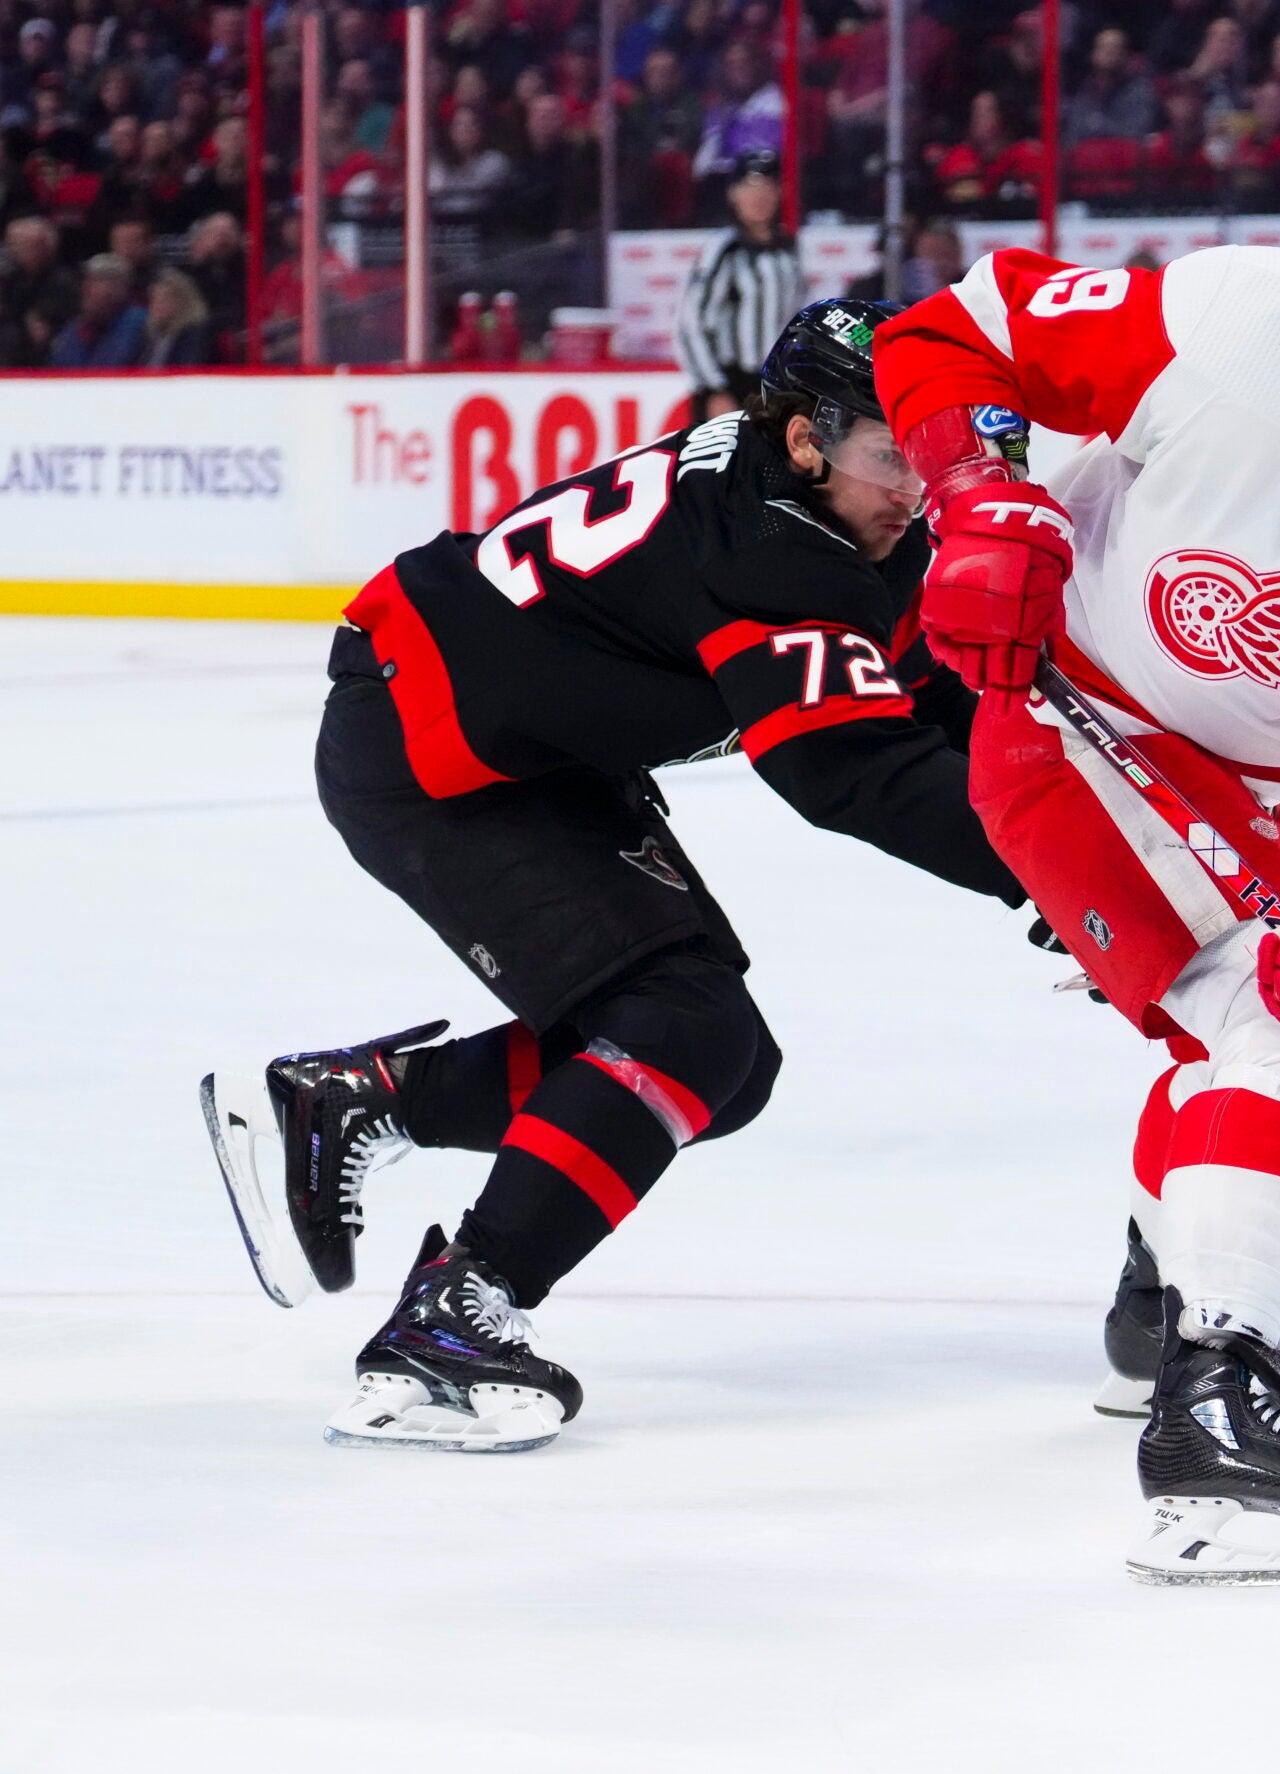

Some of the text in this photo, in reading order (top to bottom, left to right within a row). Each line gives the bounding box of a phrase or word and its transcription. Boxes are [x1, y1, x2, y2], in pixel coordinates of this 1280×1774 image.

[1026, 266, 1131, 317] 59
[0, 447, 281, 494] ANET FITNESS
[346, 401, 432, 484] The
[971, 501, 1075, 541] TR
[769, 629, 903, 711] 72
[1066, 695, 1154, 789] TRUE
